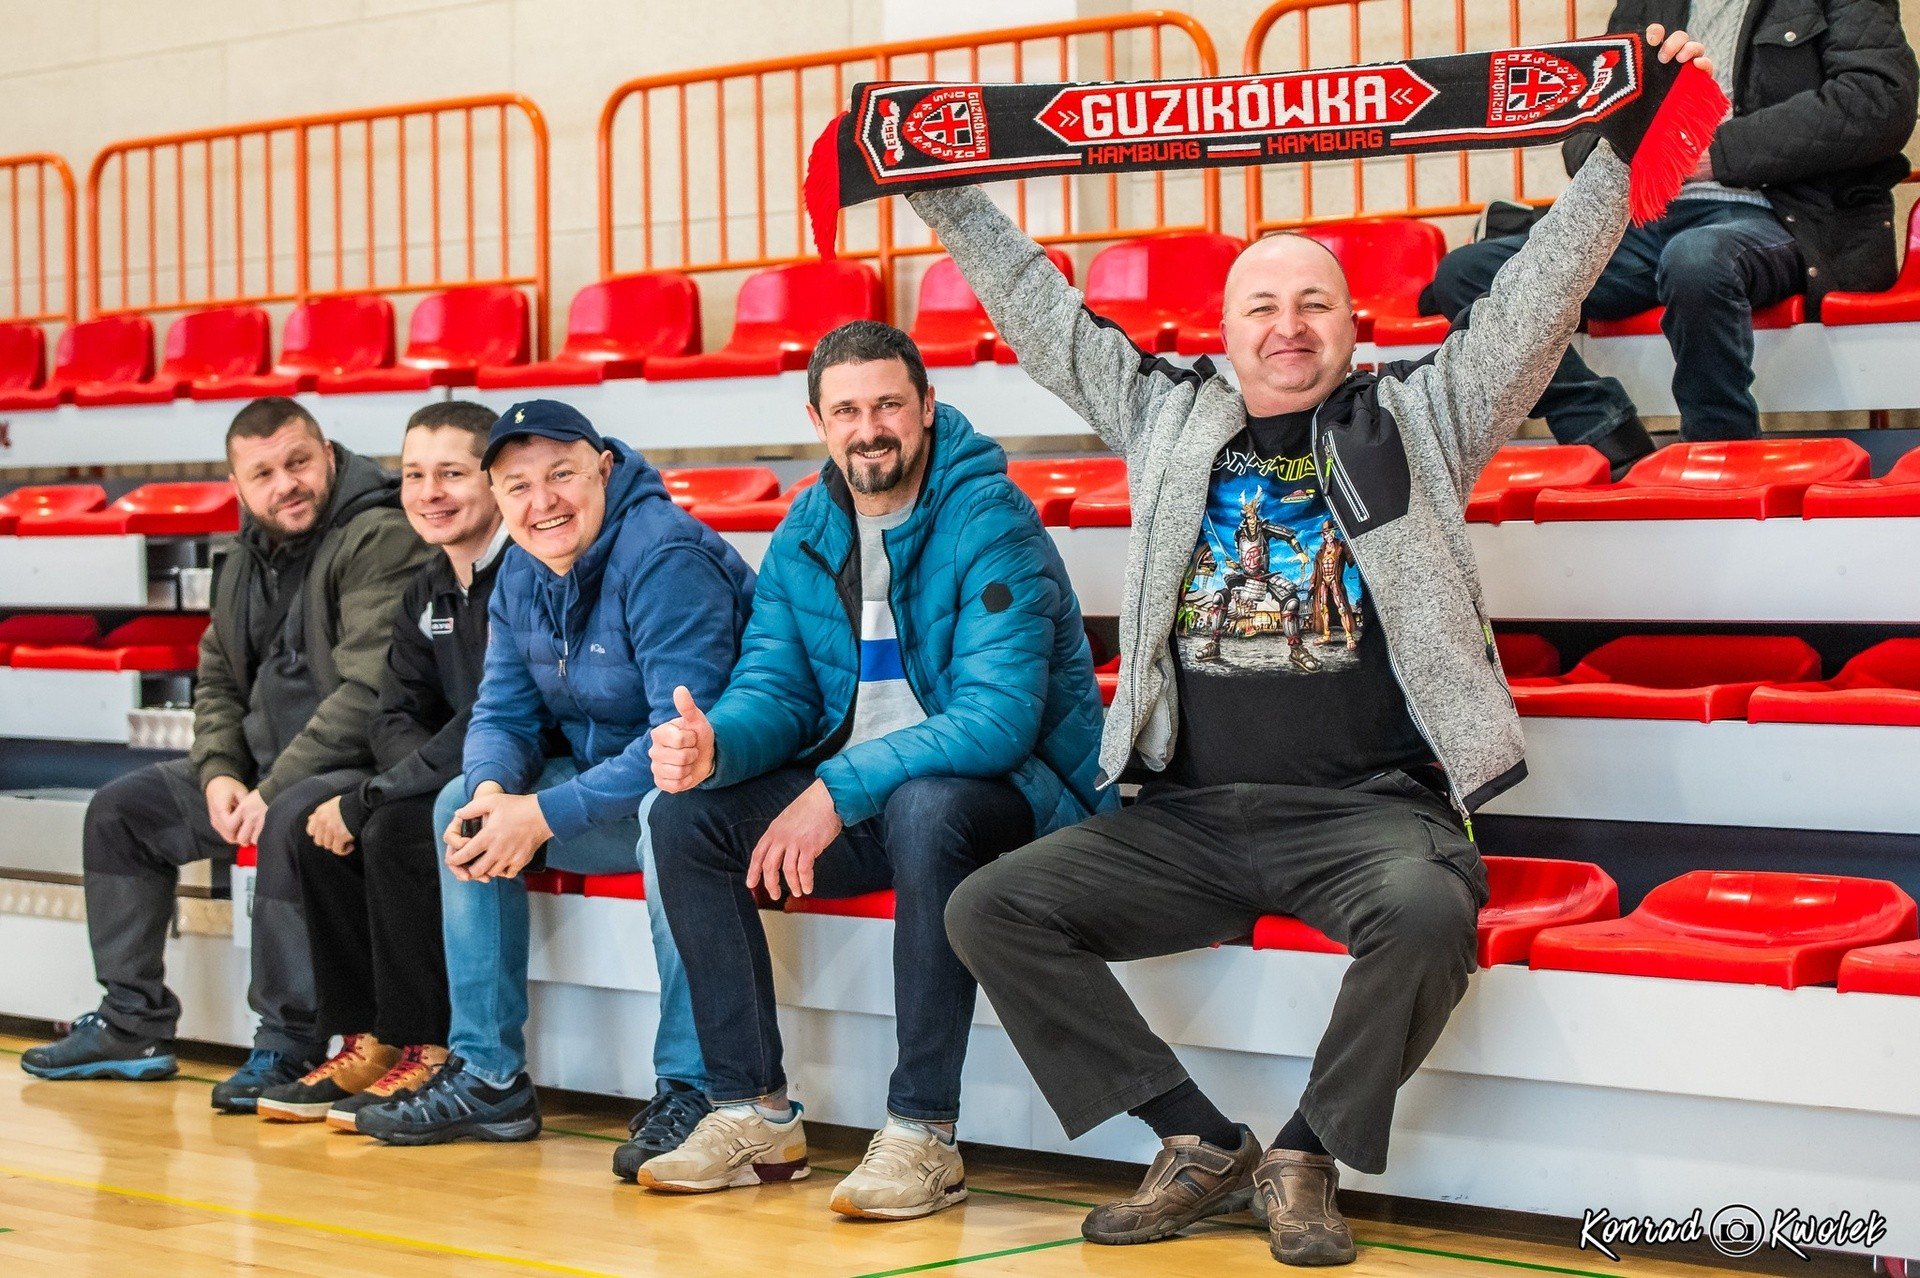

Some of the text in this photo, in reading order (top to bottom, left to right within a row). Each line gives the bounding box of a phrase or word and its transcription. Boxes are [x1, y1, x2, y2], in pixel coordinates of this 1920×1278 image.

[1491, 58, 1506, 120] GUZIKÓWKA
[1592, 71, 1607, 93] 1993
[968, 92, 986, 153] GUZIKÓWKA
[1082, 75, 1388, 139] GUZIKÓWKA
[885, 119, 897, 147] 1993
[1087, 129, 1384, 166] HAMBURG HAMBURG
